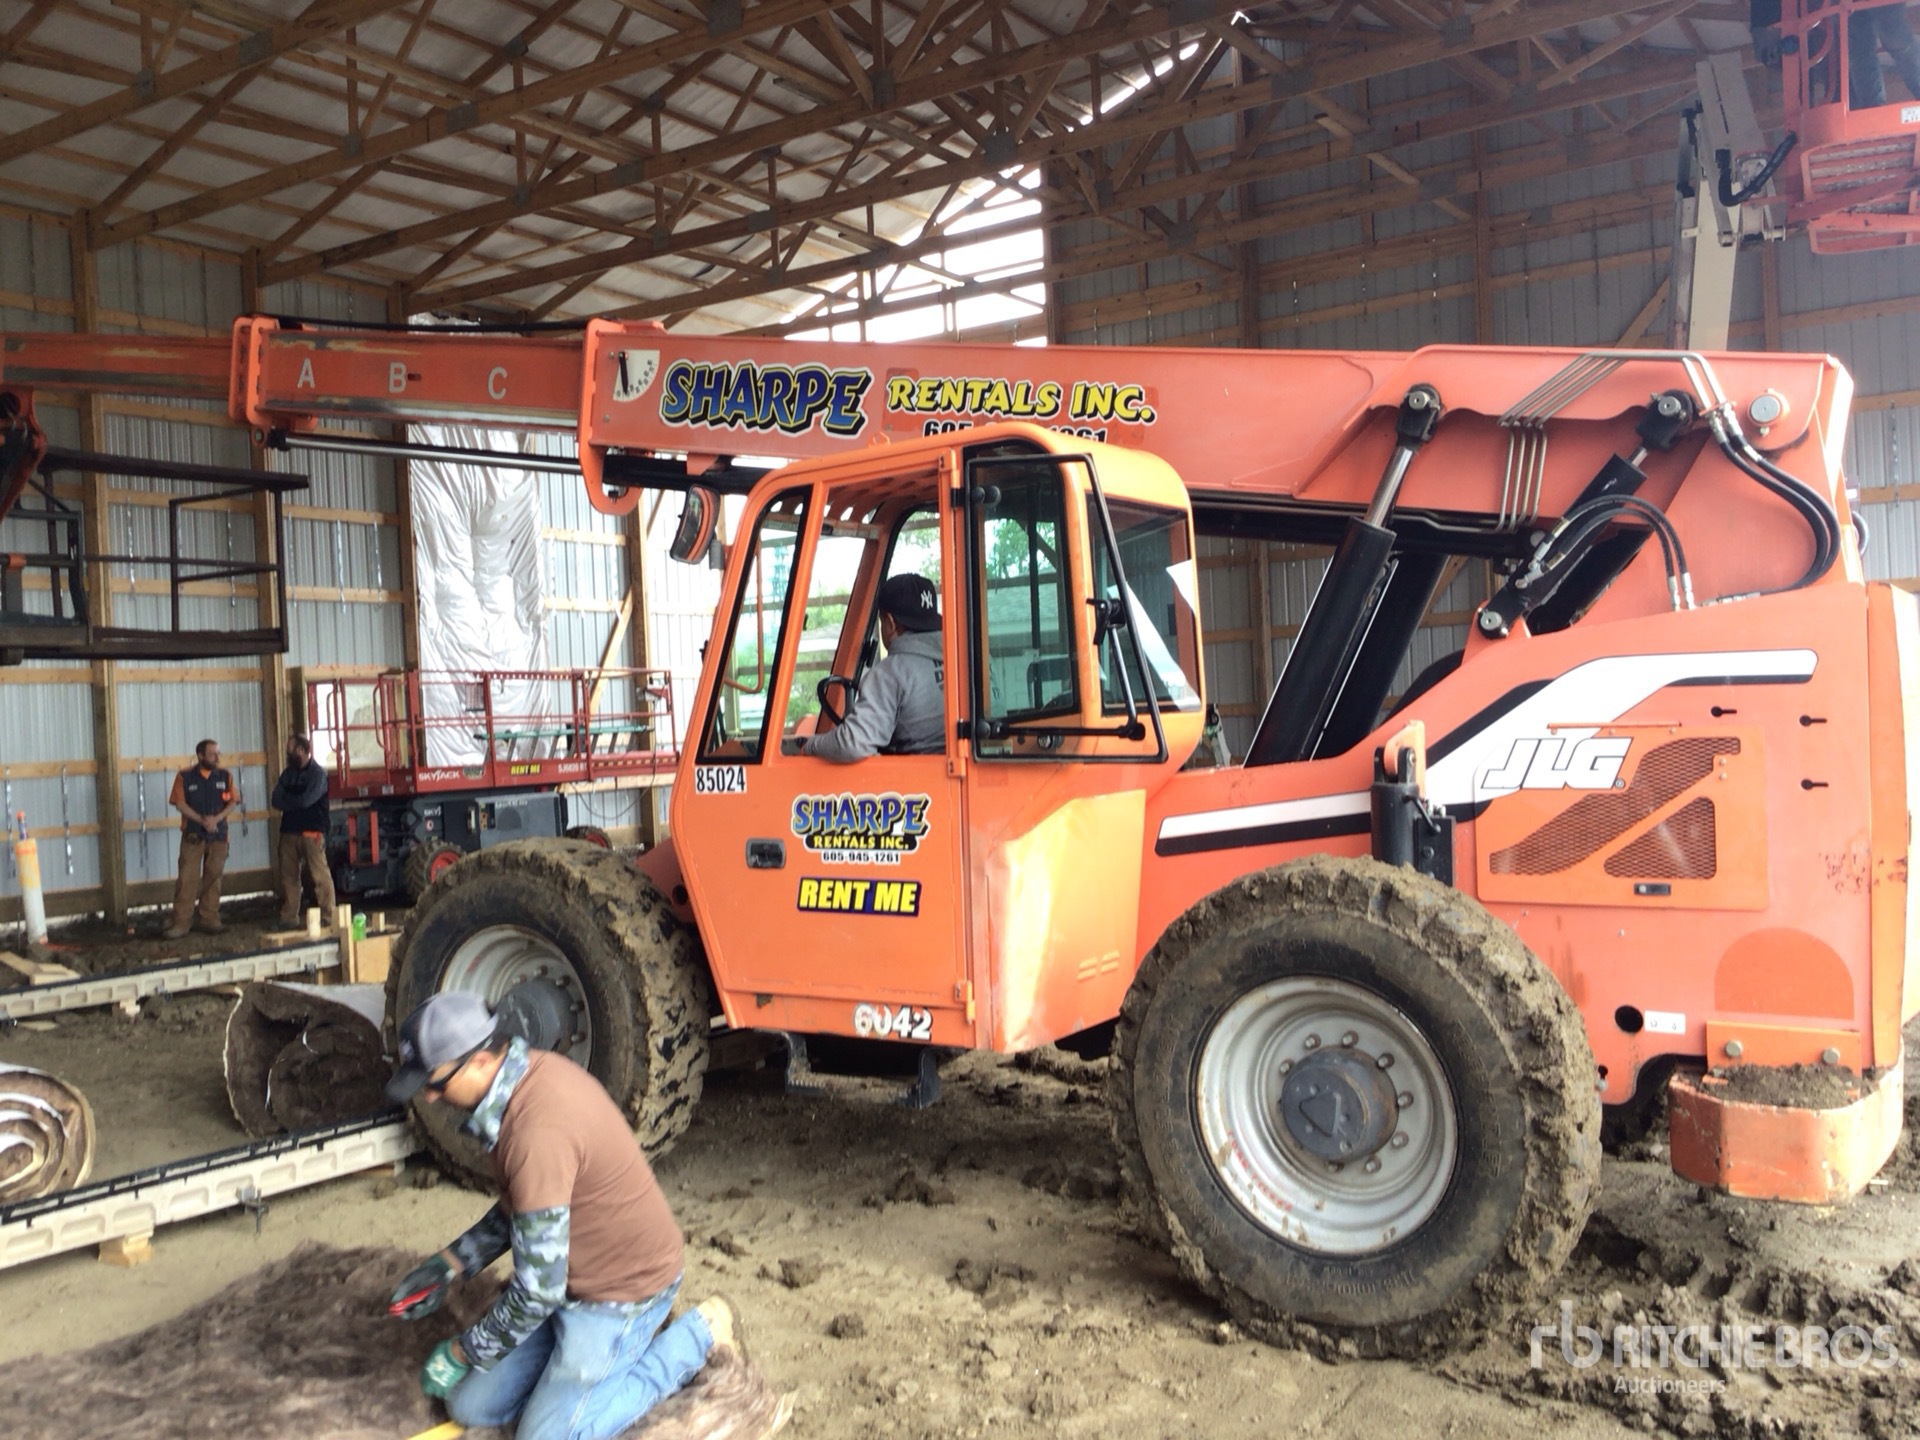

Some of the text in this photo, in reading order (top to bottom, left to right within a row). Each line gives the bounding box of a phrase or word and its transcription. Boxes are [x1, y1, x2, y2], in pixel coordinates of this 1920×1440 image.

[297, 358, 508, 399] A B C
[662, 362, 869, 435] SHARPE
[889, 377, 1061, 416] RENTALS
[1071, 383, 1156, 422] INC.
[418, 768, 461, 782] SKYJACK
[510, 764, 529, 776] RENT
[696, 767, 745, 792] 85024
[1481, 737, 1633, 790] JLG
[792, 795, 930, 836] SHARPE
[813, 835, 909, 850] RENTALS INC.
[823, 852, 899, 863] 605-945-1261
[799, 879, 918, 913] RENT ME
[854, 1002, 932, 1040] 6042
